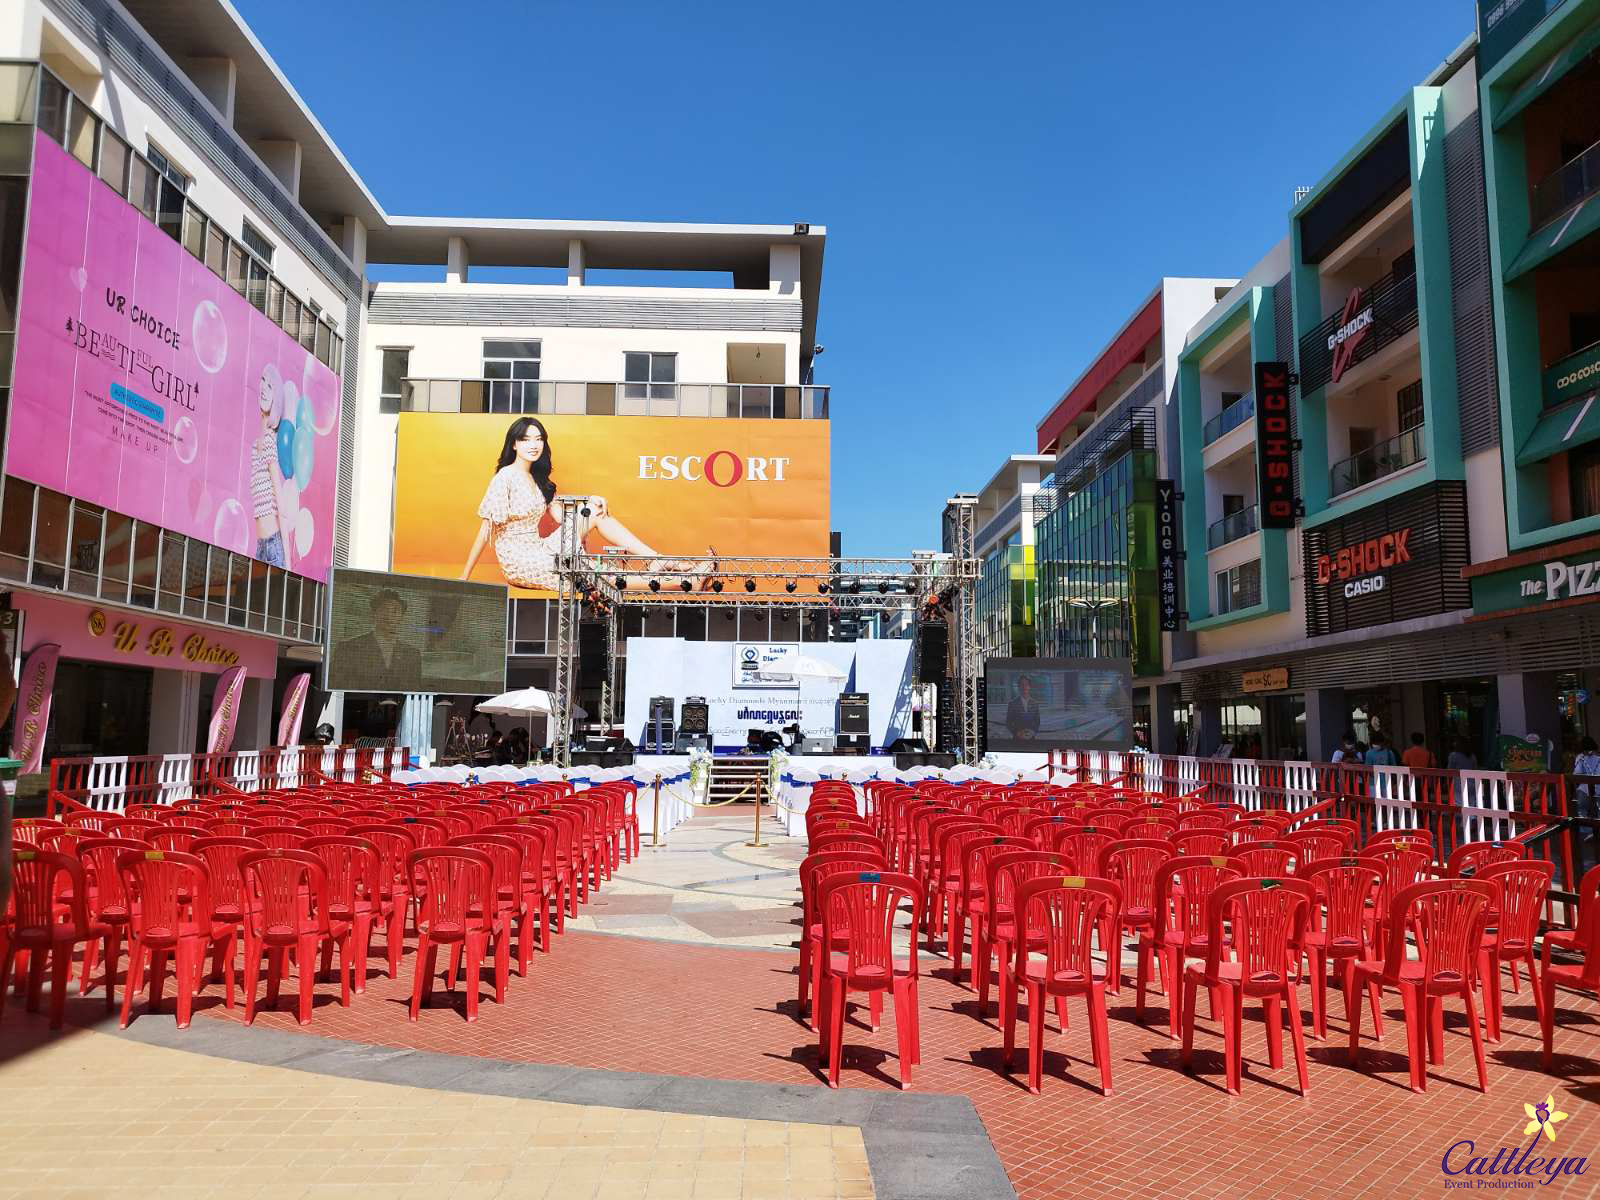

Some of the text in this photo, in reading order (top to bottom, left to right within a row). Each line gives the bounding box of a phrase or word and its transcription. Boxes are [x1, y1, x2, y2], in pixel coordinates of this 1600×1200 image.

[106, 288, 180, 350] UR CHOICE
[1328, 307, 1374, 350] G-SHOCK
[151, 366, 195, 411] GIRL
[1264, 372, 1291, 517] G-SHOCK
[638, 451, 791, 487] ESCORT
[1318, 528, 1410, 584] G-SHOCK
[1162, 556, 1176, 628] 美业培训中心
[1345, 575, 1384, 598] CASIO
[1520, 561, 1600, 600] The PIZ
[181, 633, 239, 664] Choice
